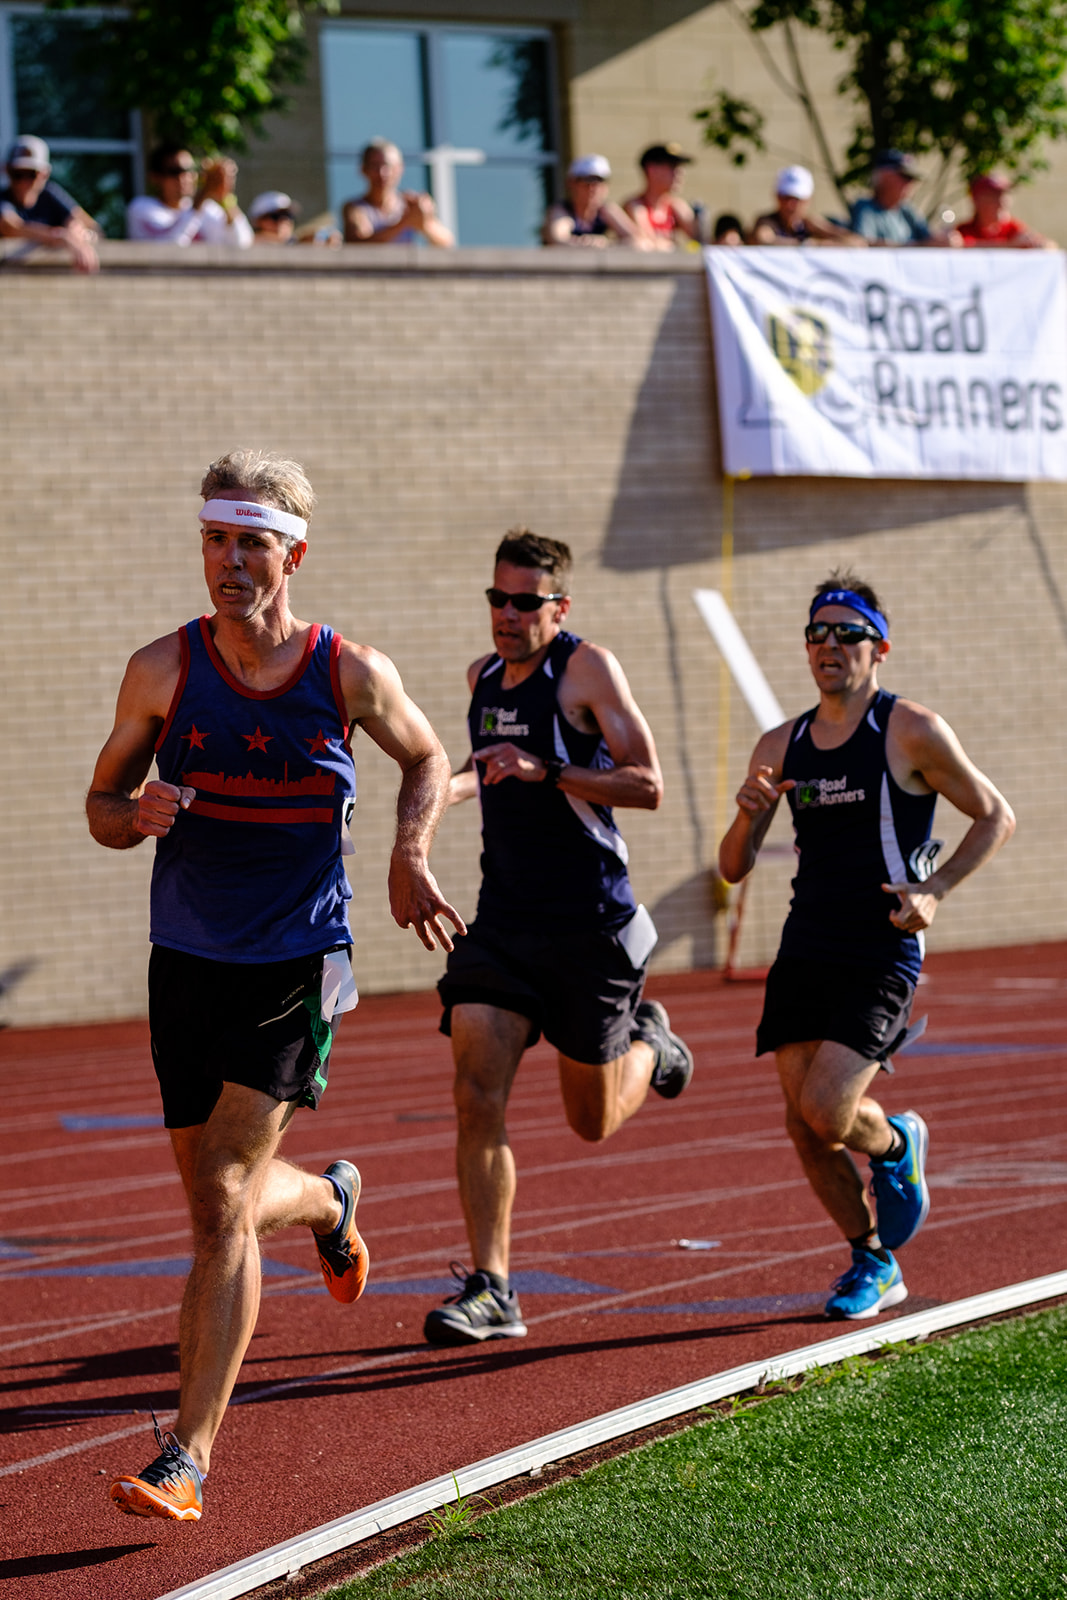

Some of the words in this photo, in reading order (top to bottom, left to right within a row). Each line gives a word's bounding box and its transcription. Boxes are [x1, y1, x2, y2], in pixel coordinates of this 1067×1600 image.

[863, 281, 987, 354] Road
[872, 357, 1065, 433] Runners
[235, 508, 262, 518] Wilson
[819, 774, 847, 793] Road
[819, 788, 866, 806] Runners
